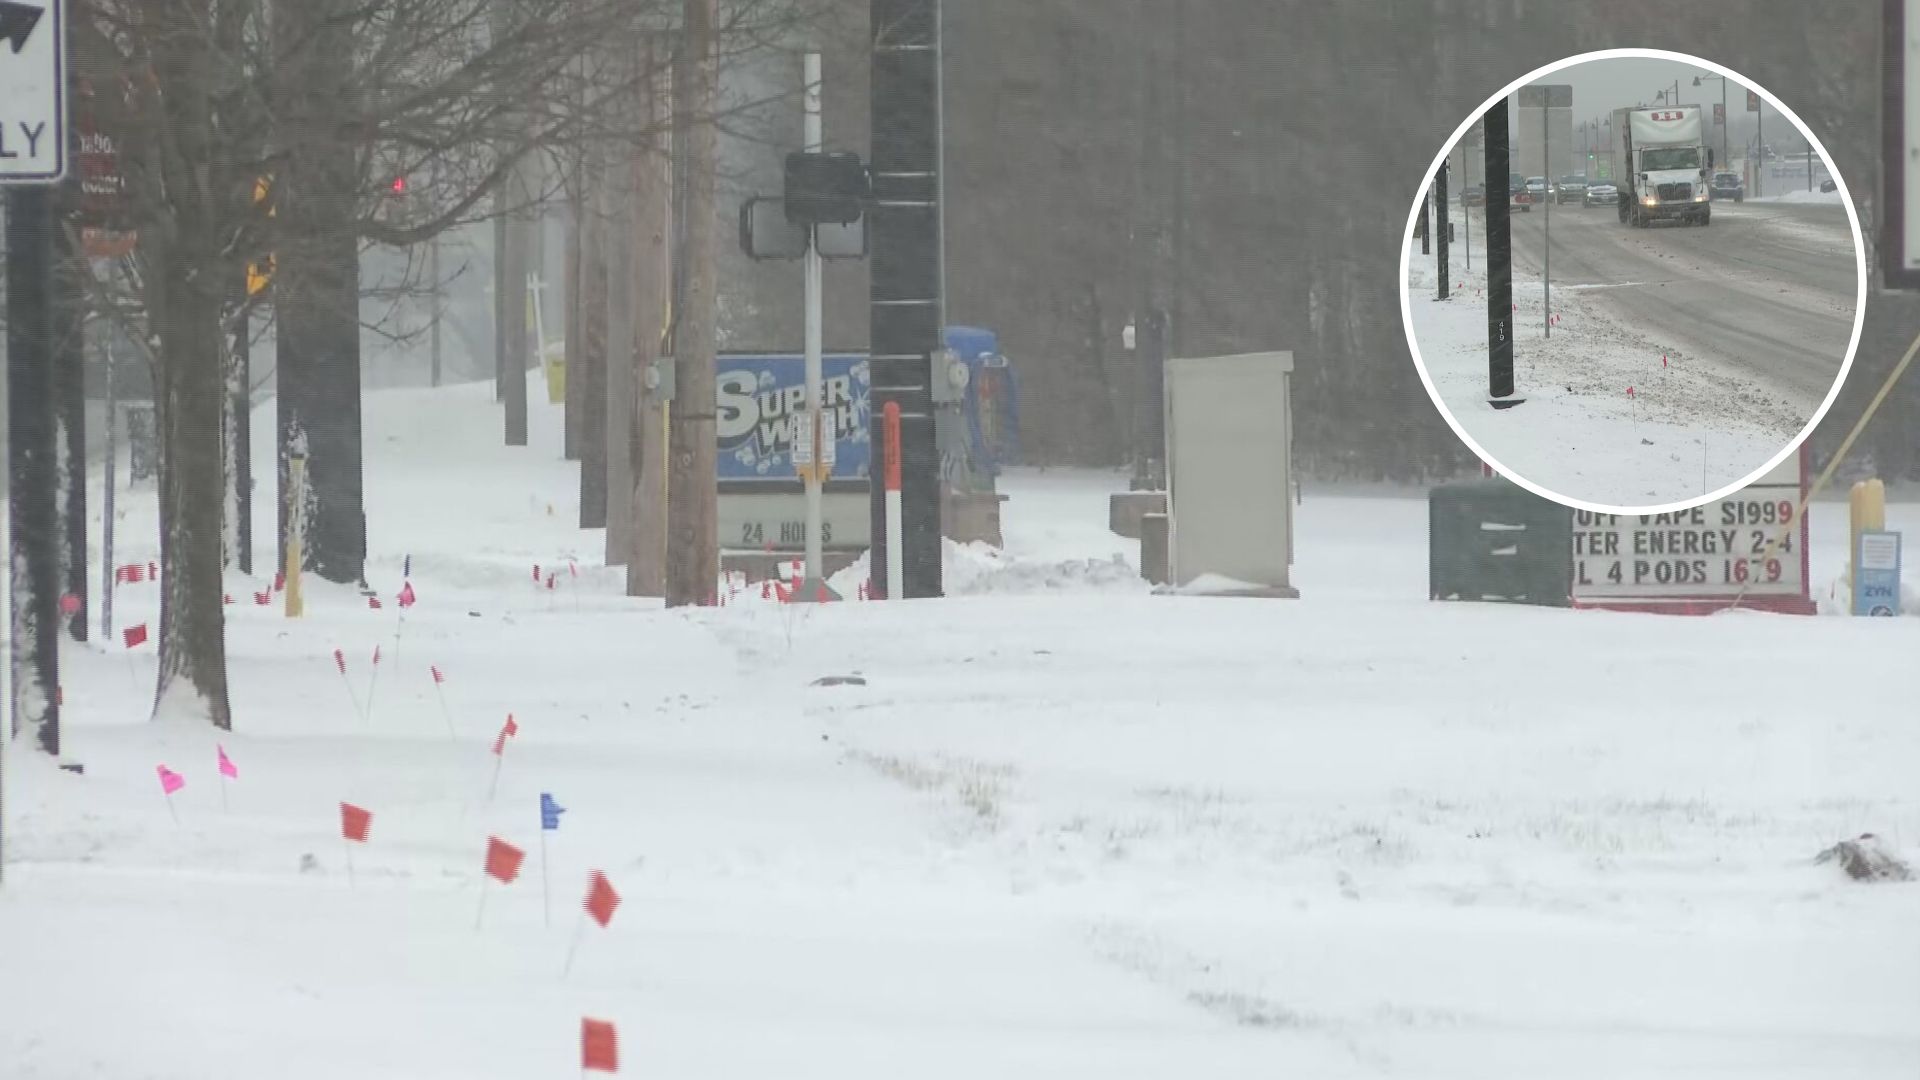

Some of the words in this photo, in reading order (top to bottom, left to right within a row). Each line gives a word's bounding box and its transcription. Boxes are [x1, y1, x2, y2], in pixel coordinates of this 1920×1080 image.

[716, 369, 852, 438] SUPR
[760, 405, 859, 446] WH
[743, 522, 763, 543] 24
[780, 521, 831, 543] HOS
[1573, 531, 1619, 555] TER
[1633, 530, 1737, 554] ENERGY
[1751, 530, 1792, 553] 2-4
[1607, 560, 1622, 584] 4
[1634, 560, 1706, 584] PODS
[1865, 586, 1892, 597] ZYN
